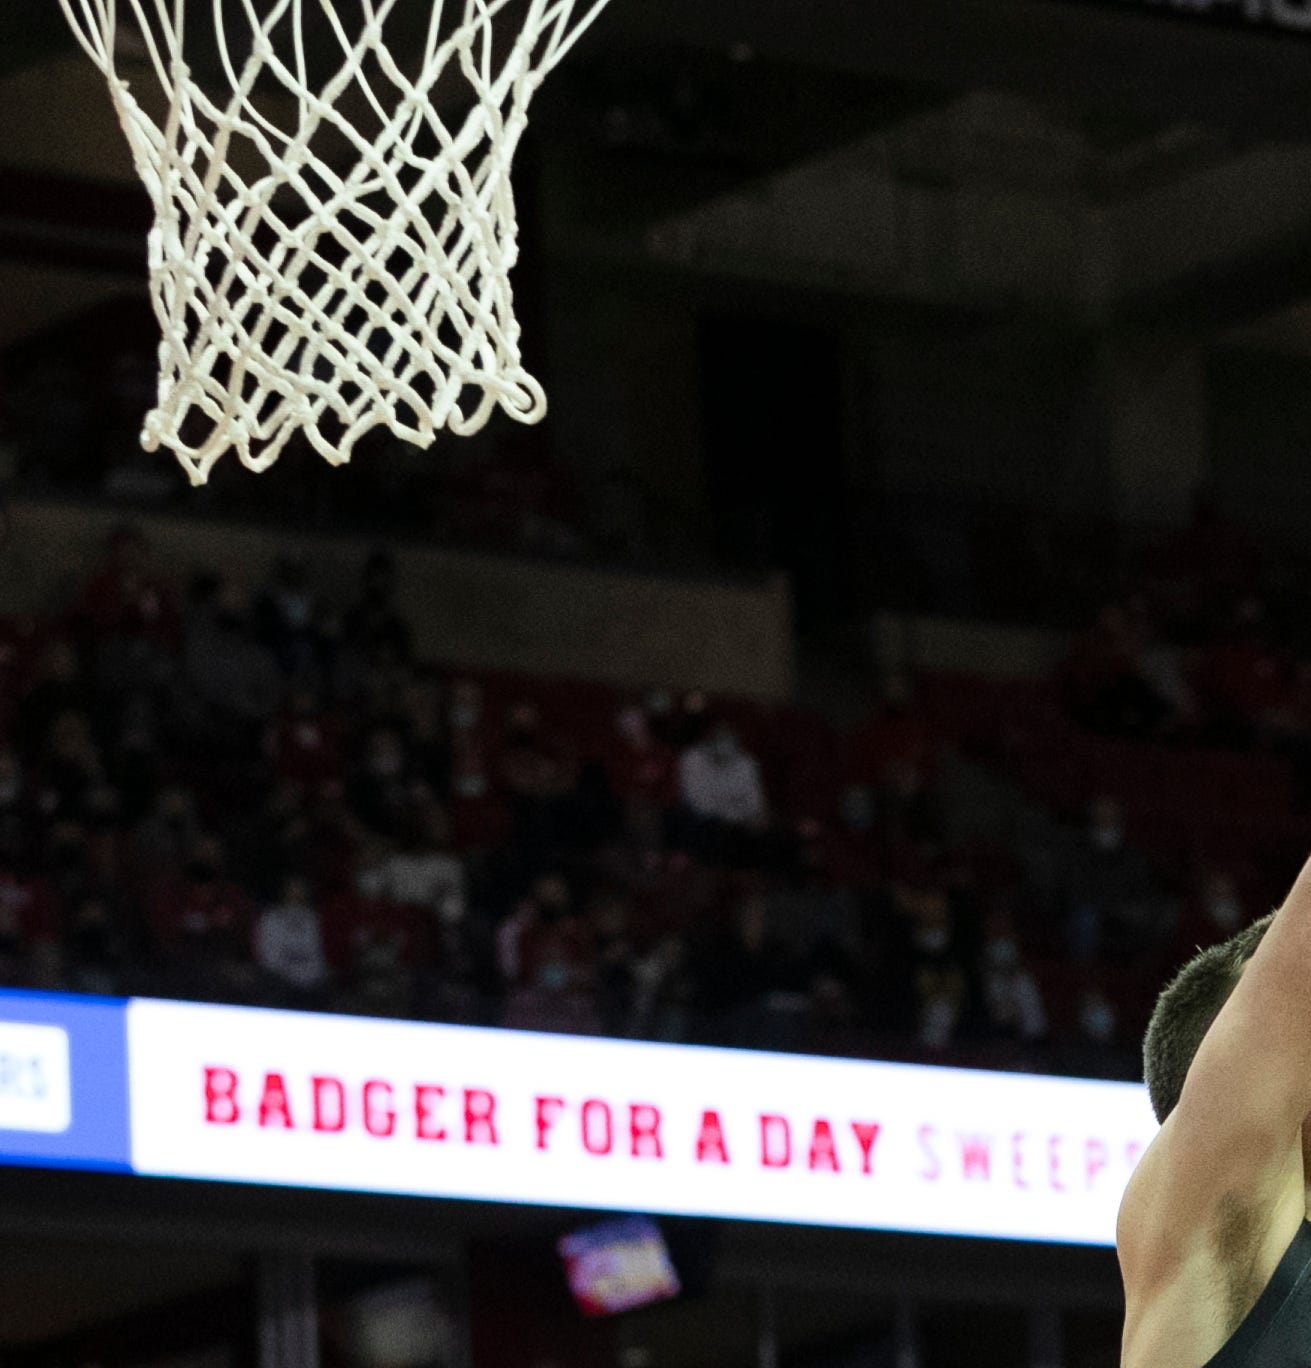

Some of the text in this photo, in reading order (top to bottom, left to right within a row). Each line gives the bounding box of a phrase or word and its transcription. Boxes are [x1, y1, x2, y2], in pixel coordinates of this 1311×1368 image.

[204, 1066, 499, 1146] BADGER
[535, 1096, 664, 1160] FOR
[696, 1109, 730, 1164] A
[759, 1113, 880, 1175] DAY
